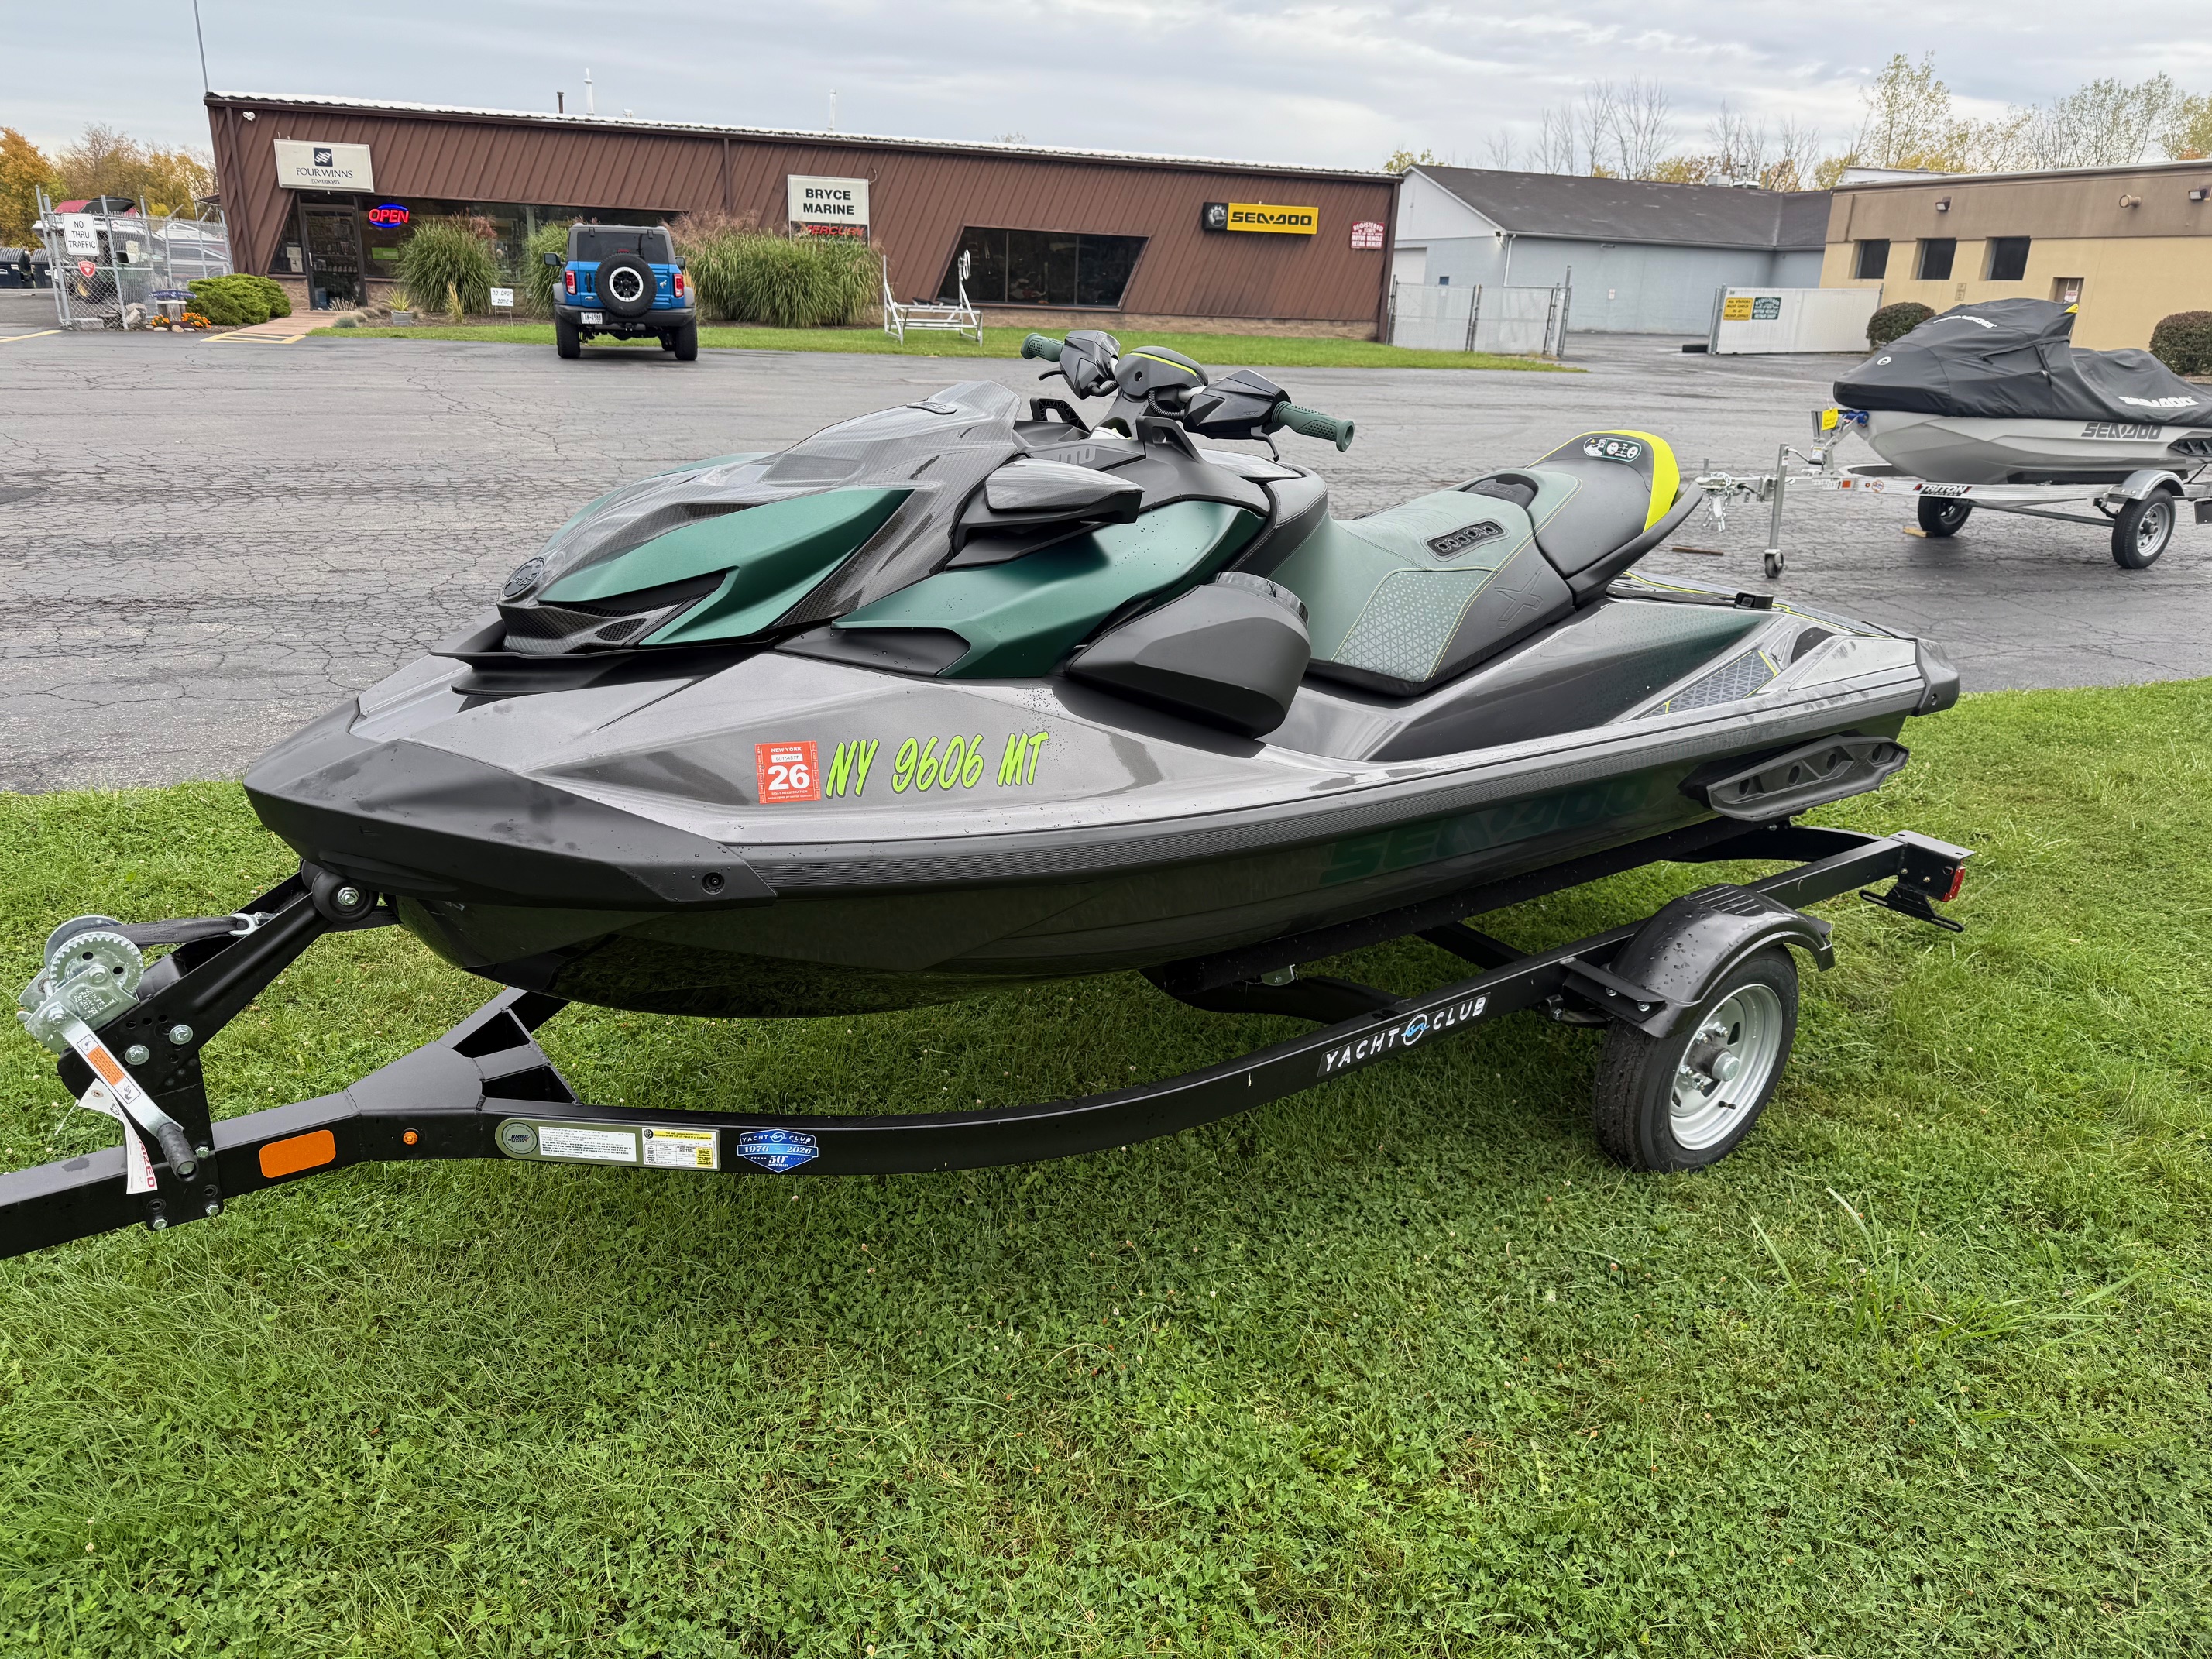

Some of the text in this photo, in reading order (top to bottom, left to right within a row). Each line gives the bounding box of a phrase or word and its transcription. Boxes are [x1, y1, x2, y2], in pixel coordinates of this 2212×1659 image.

[296, 167, 353, 178] FOUR WINNS
[805, 188, 851, 201] BRYCE
[803, 203, 854, 215] MARINE
[369, 208, 410, 223] OPEN
[71, 230, 89, 239] THRU
[68, 240, 96, 249] TRAFFIC
[1921, 484, 1967, 493] TRITON
[826, 731, 1049, 799] NY 9606 MT
[768, 764, 810, 790] 26
[1326, 997, 1486, 1072] YACHT CLUB
